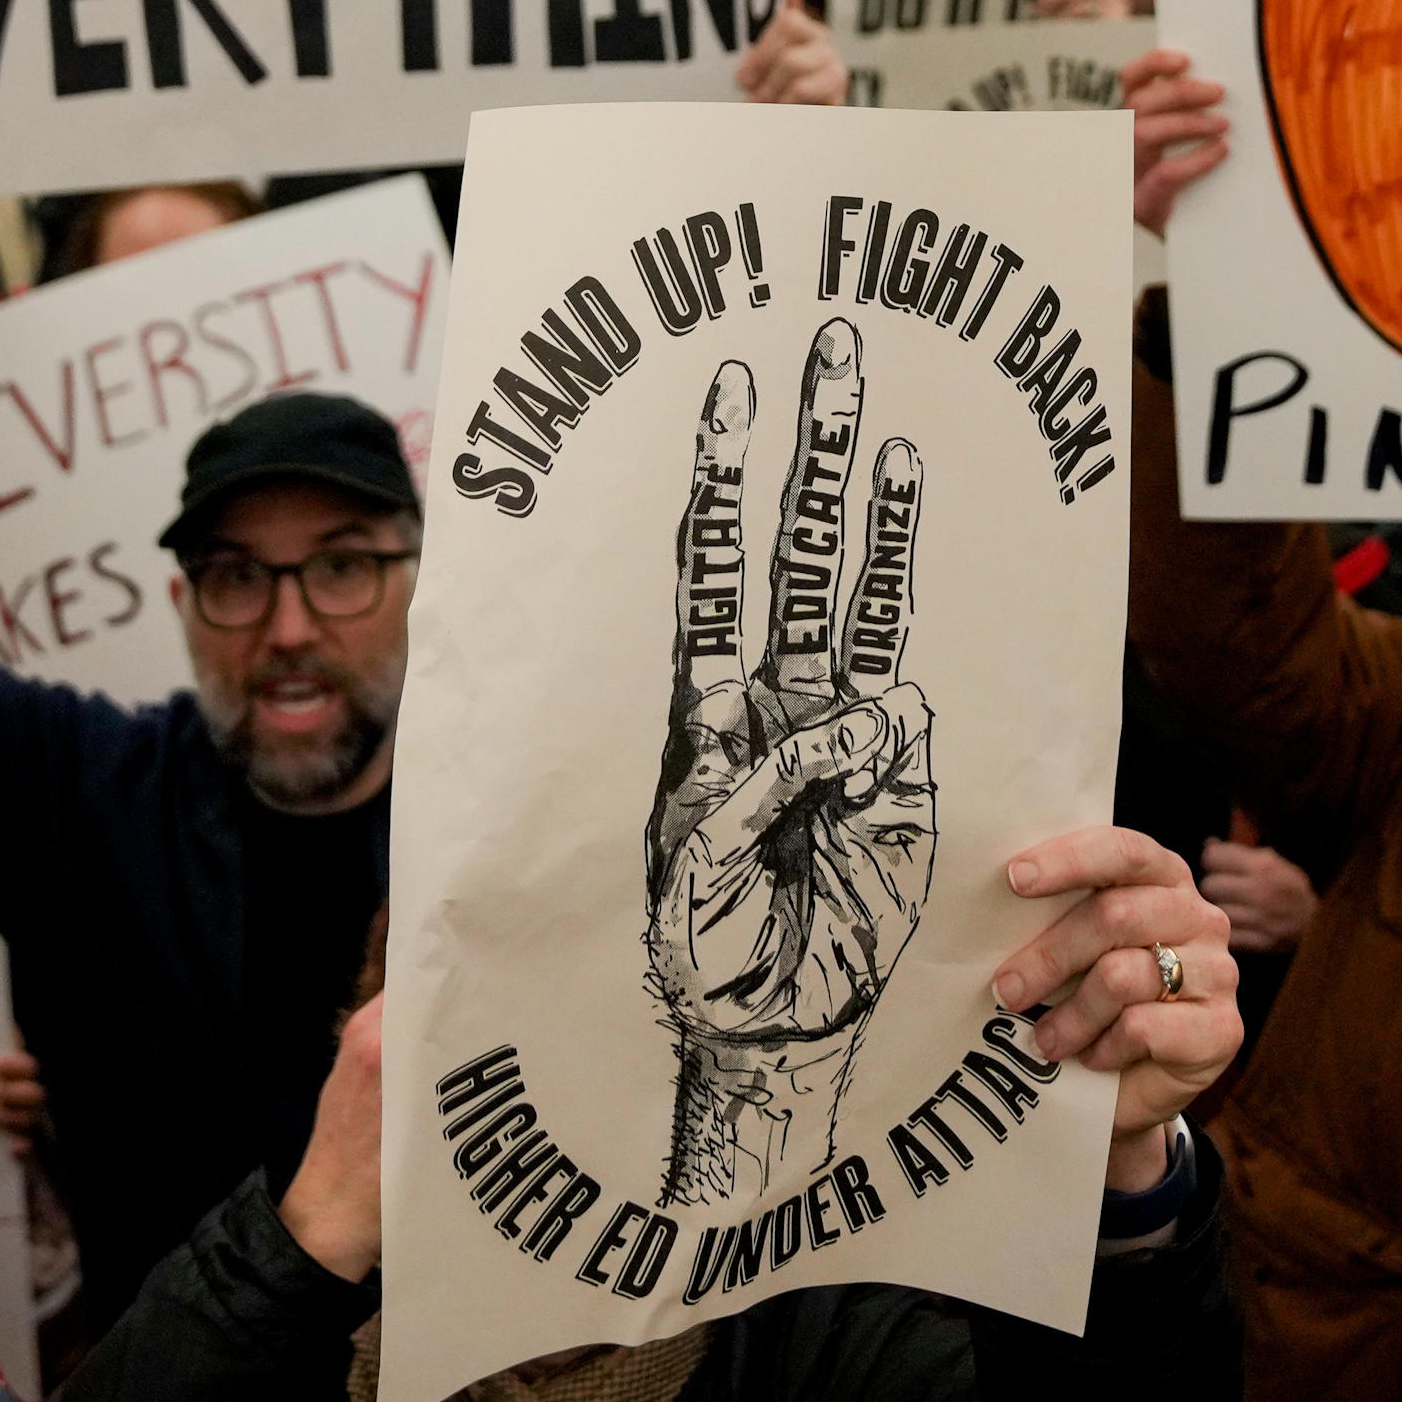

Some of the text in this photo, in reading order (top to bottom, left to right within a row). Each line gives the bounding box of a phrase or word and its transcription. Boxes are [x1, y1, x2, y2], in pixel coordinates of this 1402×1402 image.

[451, 275, 642, 519] STAND
[629, 202, 770, 337] UP!
[817, 195, 1024, 343] FIGHT
[993, 284, 1117, 506] BACK!
[687, 462, 743, 657] AGITATE
[776, 421, 851, 655] EDUCATE
[850, 477, 916, 675] ORGANIZE
[436, 1043, 601, 1263] HIGHER
[575, 1202, 678, 1300] ED
[682, 1154, 886, 1306] UNDER
